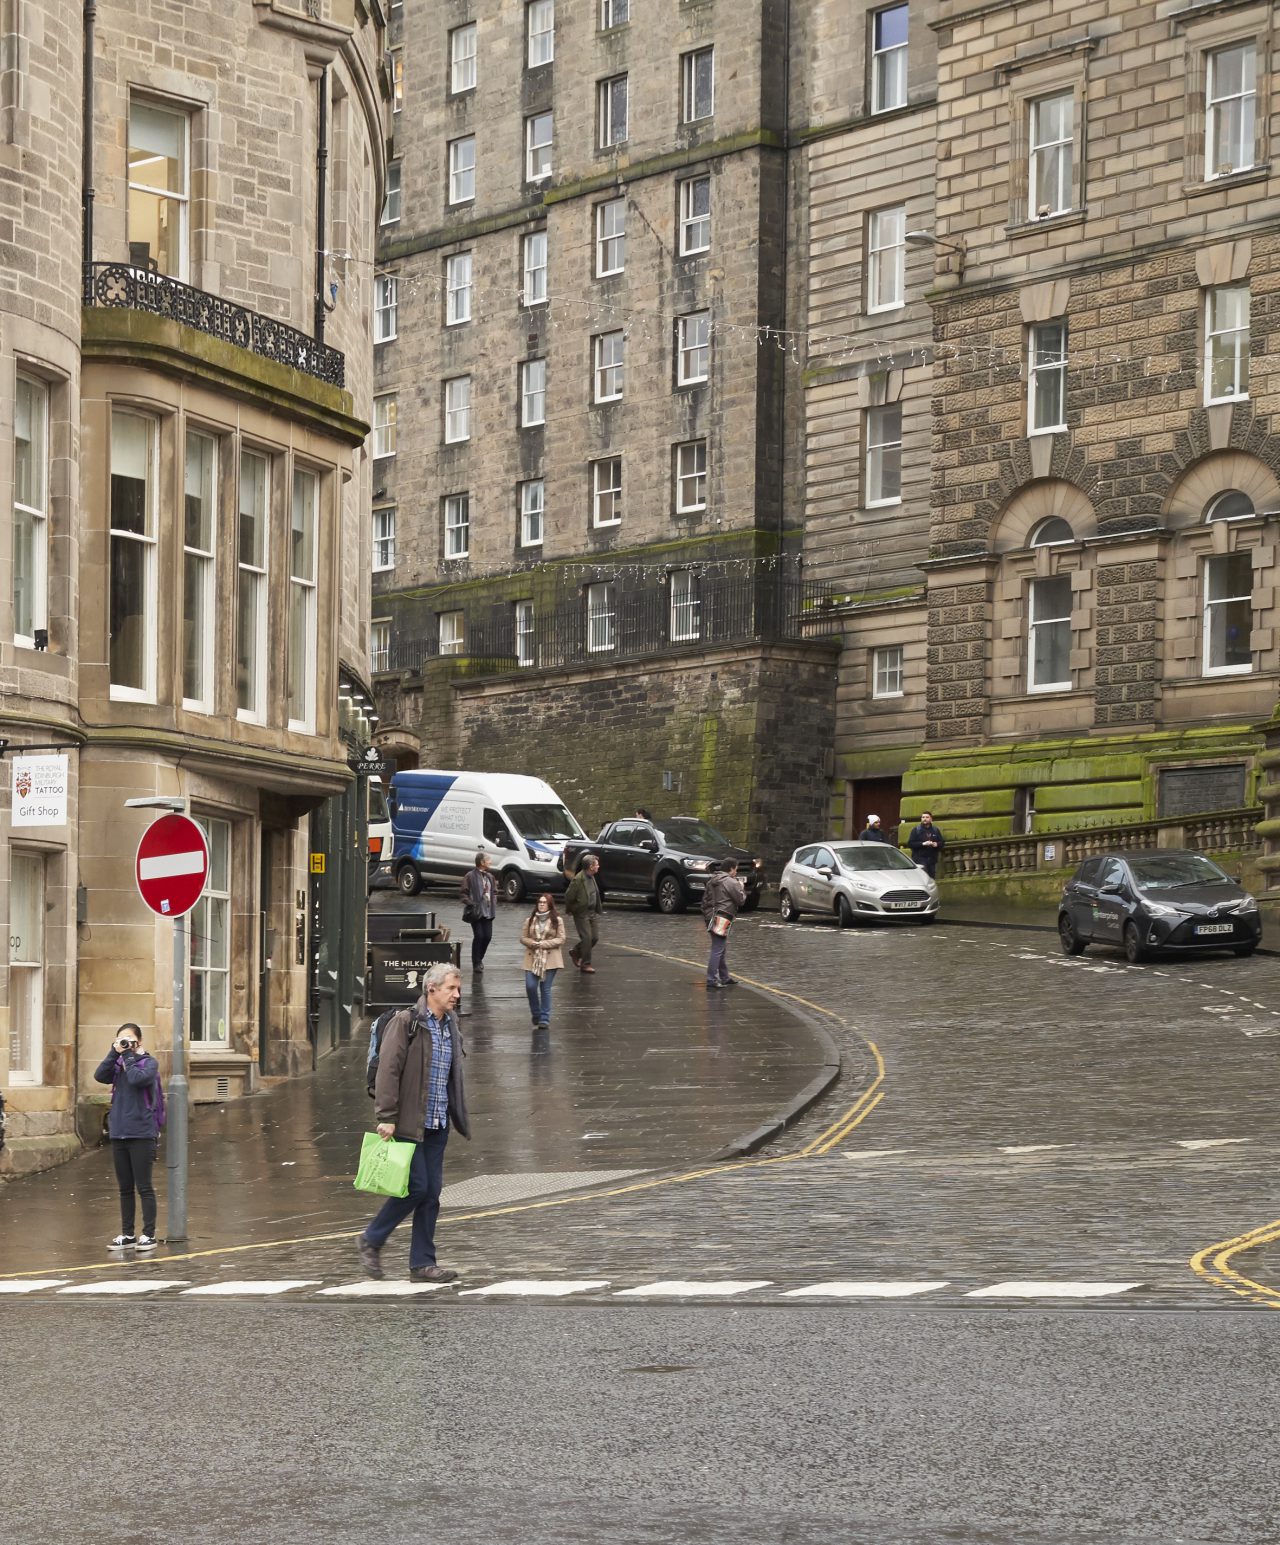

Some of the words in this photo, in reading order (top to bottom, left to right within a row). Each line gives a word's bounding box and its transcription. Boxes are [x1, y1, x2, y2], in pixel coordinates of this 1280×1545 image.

[35, 786, 64, 794] TATTOO
[20, 805, 35, 816] Gift
[38, 806, 59, 817] Shop
[312, 855, 323, 871] H
